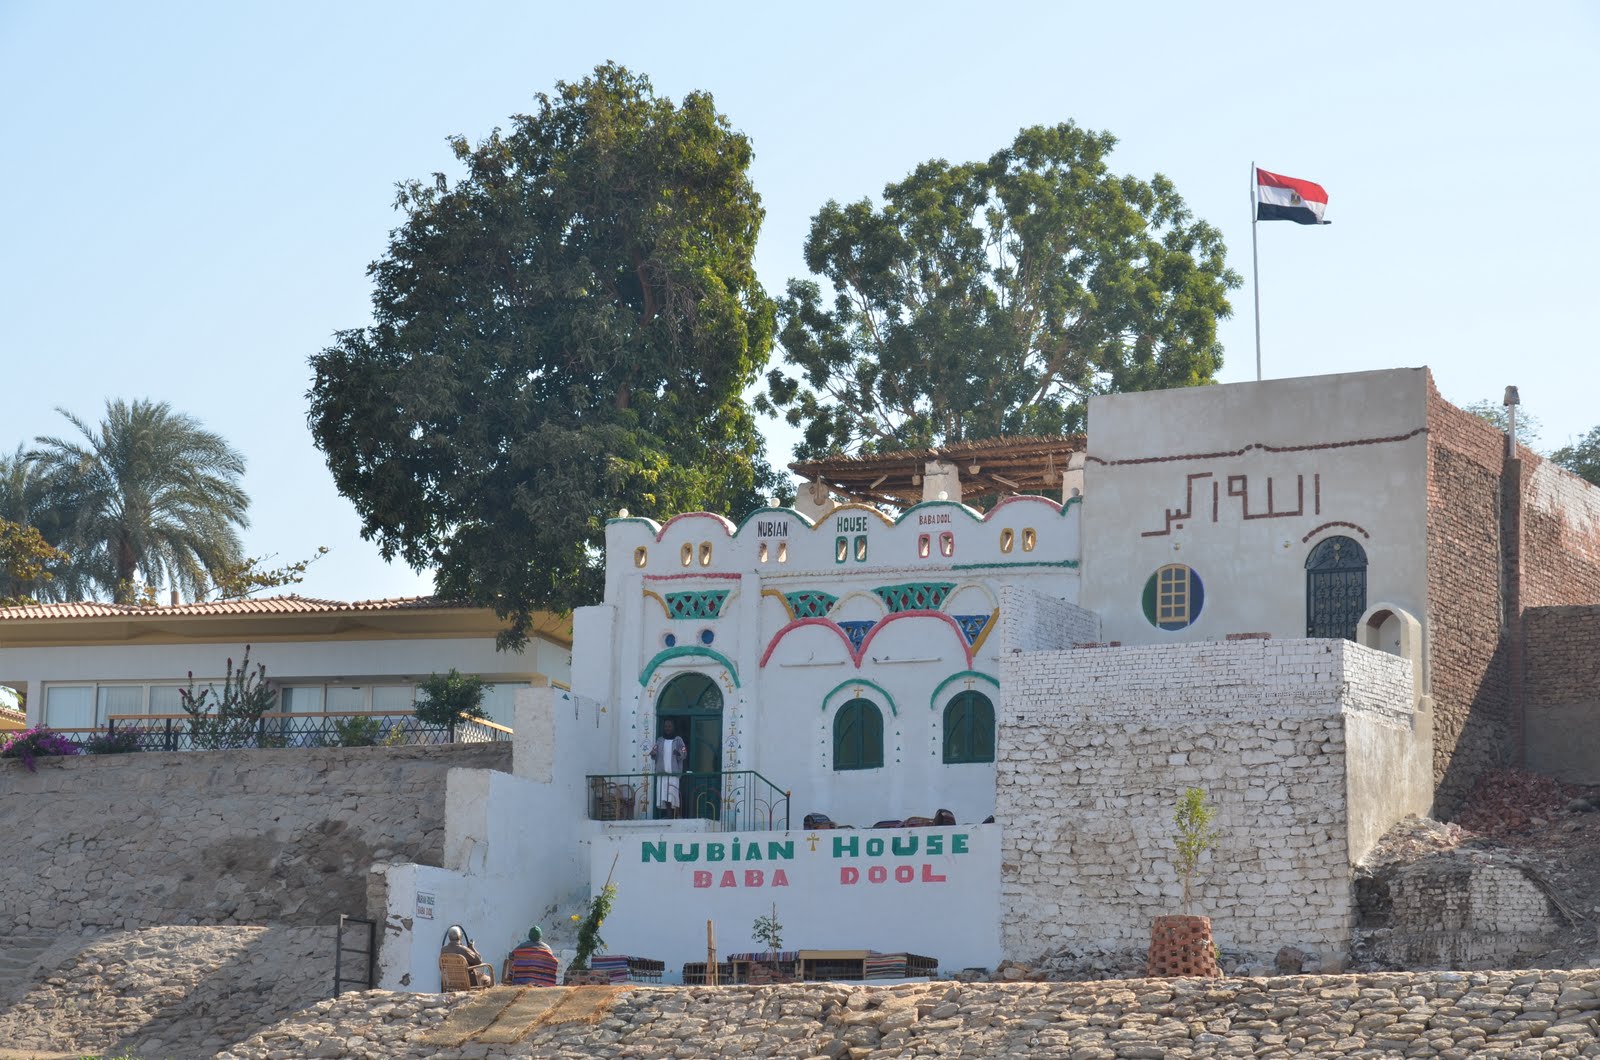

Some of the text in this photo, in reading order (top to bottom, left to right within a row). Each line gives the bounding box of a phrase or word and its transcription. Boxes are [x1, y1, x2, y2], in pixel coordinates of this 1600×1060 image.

[837, 516, 867, 533] HOUSE
[919, 514, 936, 526] BABA
[936, 513, 952, 524] DOOL
[832, 834, 969, 858] HOUSE
[693, 864, 946, 888] BABA DOOL
